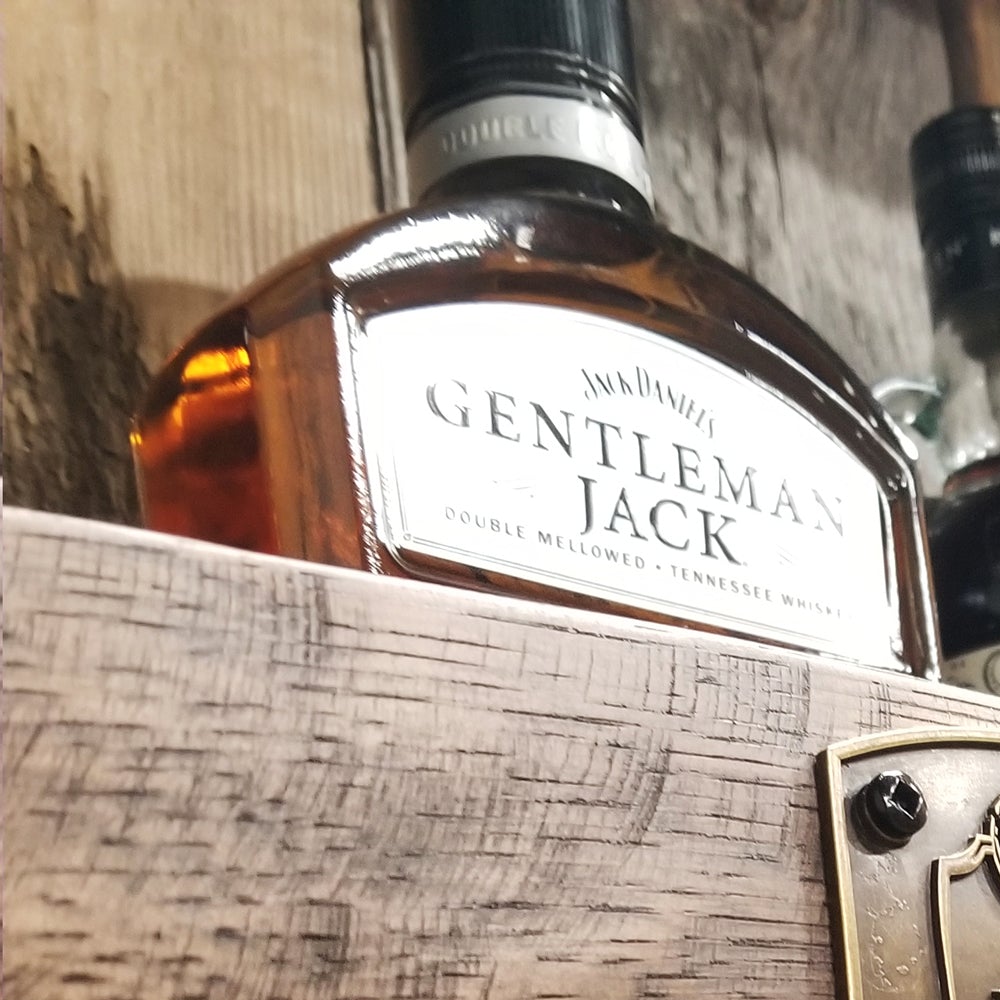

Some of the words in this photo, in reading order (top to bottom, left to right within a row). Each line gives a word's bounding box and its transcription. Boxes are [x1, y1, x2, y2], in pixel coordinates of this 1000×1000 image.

[426, 379, 844, 537] GENTLEMAN
[445, 506, 526, 540] DOUBLE
[538, 530, 646, 570] MELLOWED
[670, 564, 773, 602] TENNESSEE
[577, 475, 738, 564] JACK
